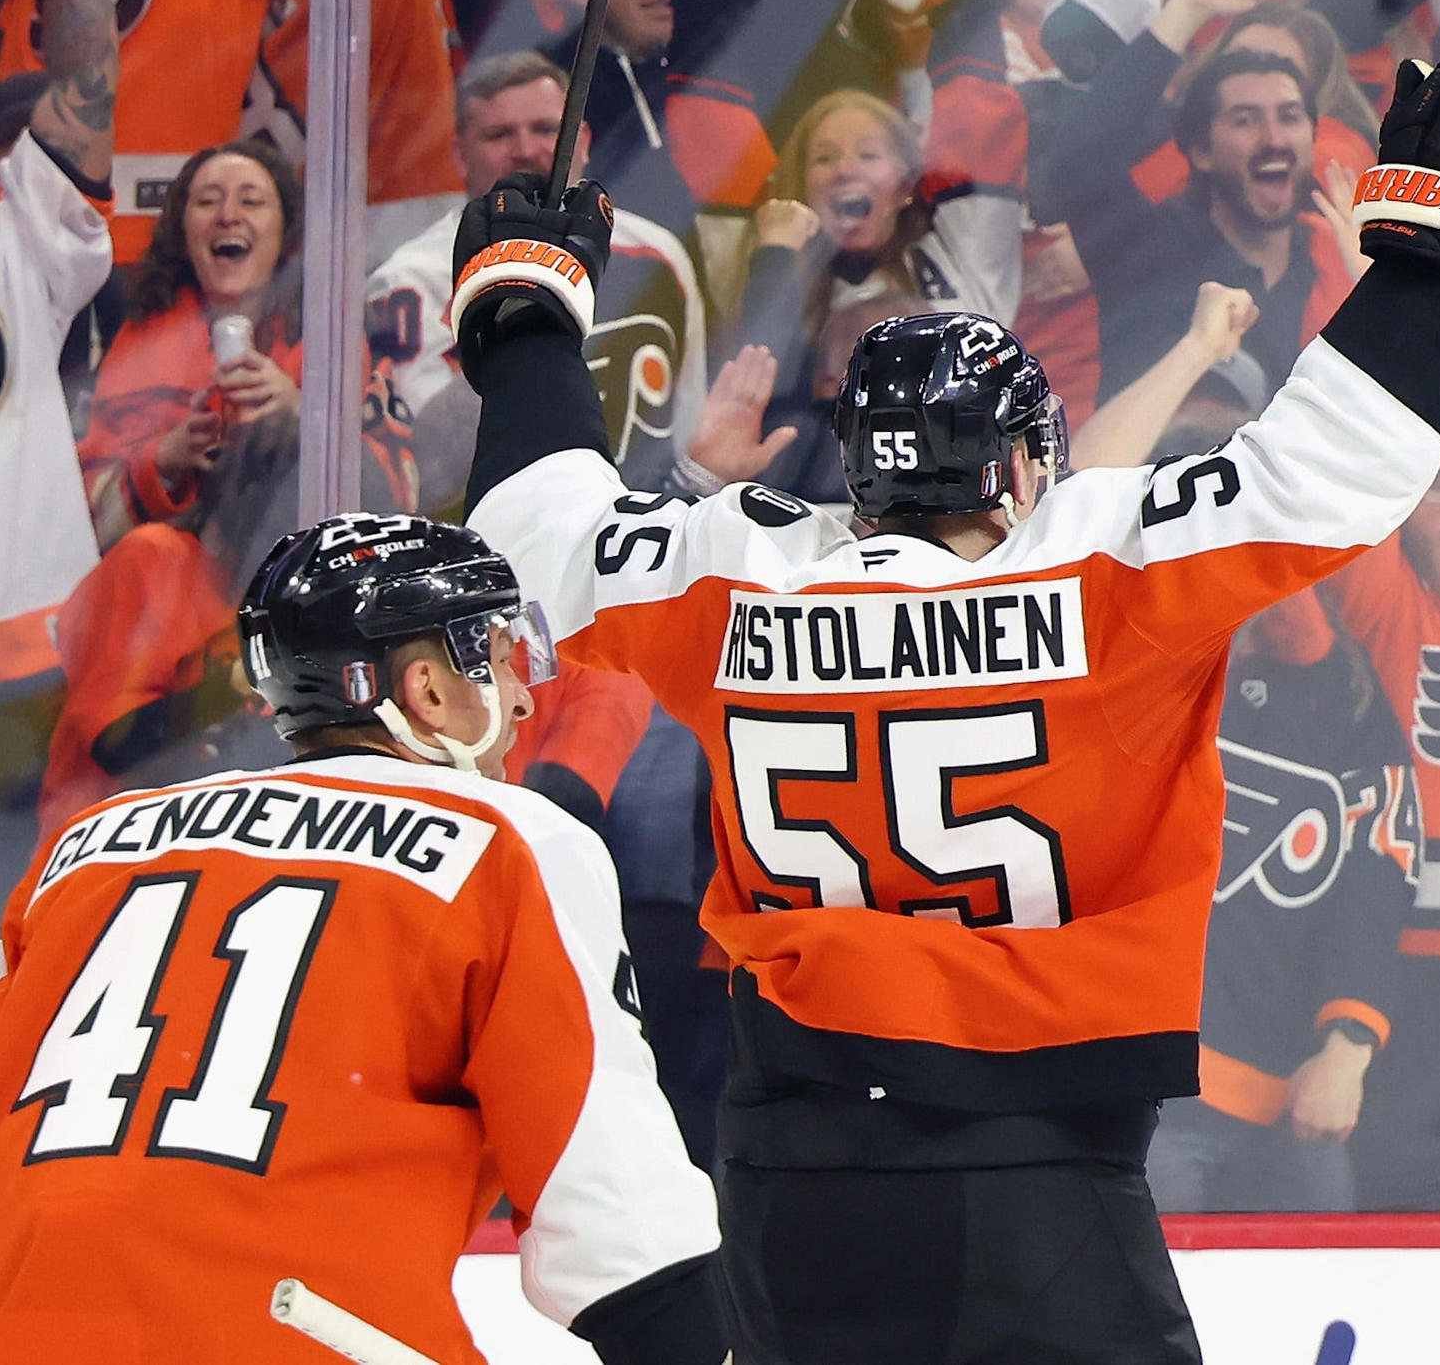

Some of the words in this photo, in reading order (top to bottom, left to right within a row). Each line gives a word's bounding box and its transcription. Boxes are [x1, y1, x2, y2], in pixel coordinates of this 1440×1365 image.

[872, 431, 919, 471] 55
[1142, 446, 1242, 529] 5
[328, 538, 426, 570] CHEVROLET
[725, 591, 1065, 683] RISTOLAINEN
[43, 785, 460, 882] GLENDENING
[724, 699, 1072, 928] 55
[9, 868, 338, 1177] 41
